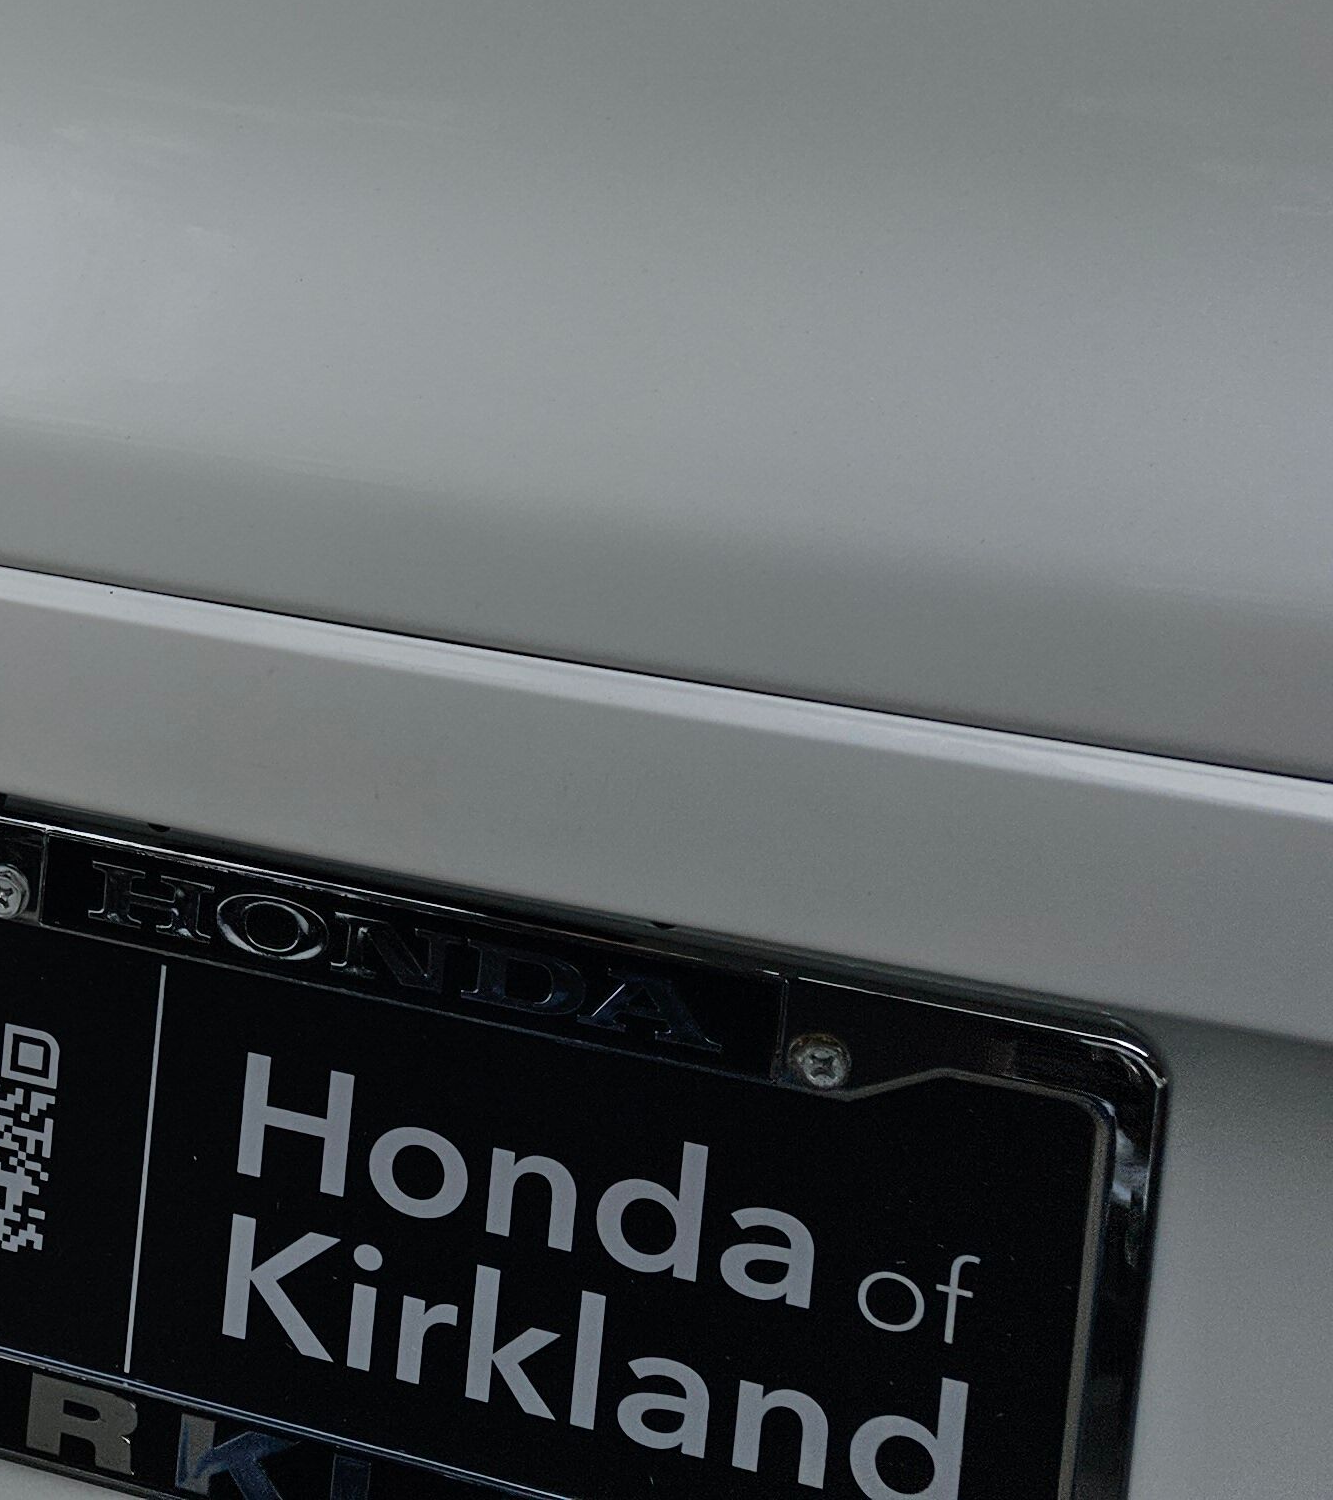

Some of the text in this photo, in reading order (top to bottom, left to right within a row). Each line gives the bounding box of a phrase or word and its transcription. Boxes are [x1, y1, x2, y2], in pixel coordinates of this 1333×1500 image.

[86, 859, 724, 1054] HONDA
[236, 1051, 981, 1345] Honda of
[221, 1213, 970, 1500] Kirkland
